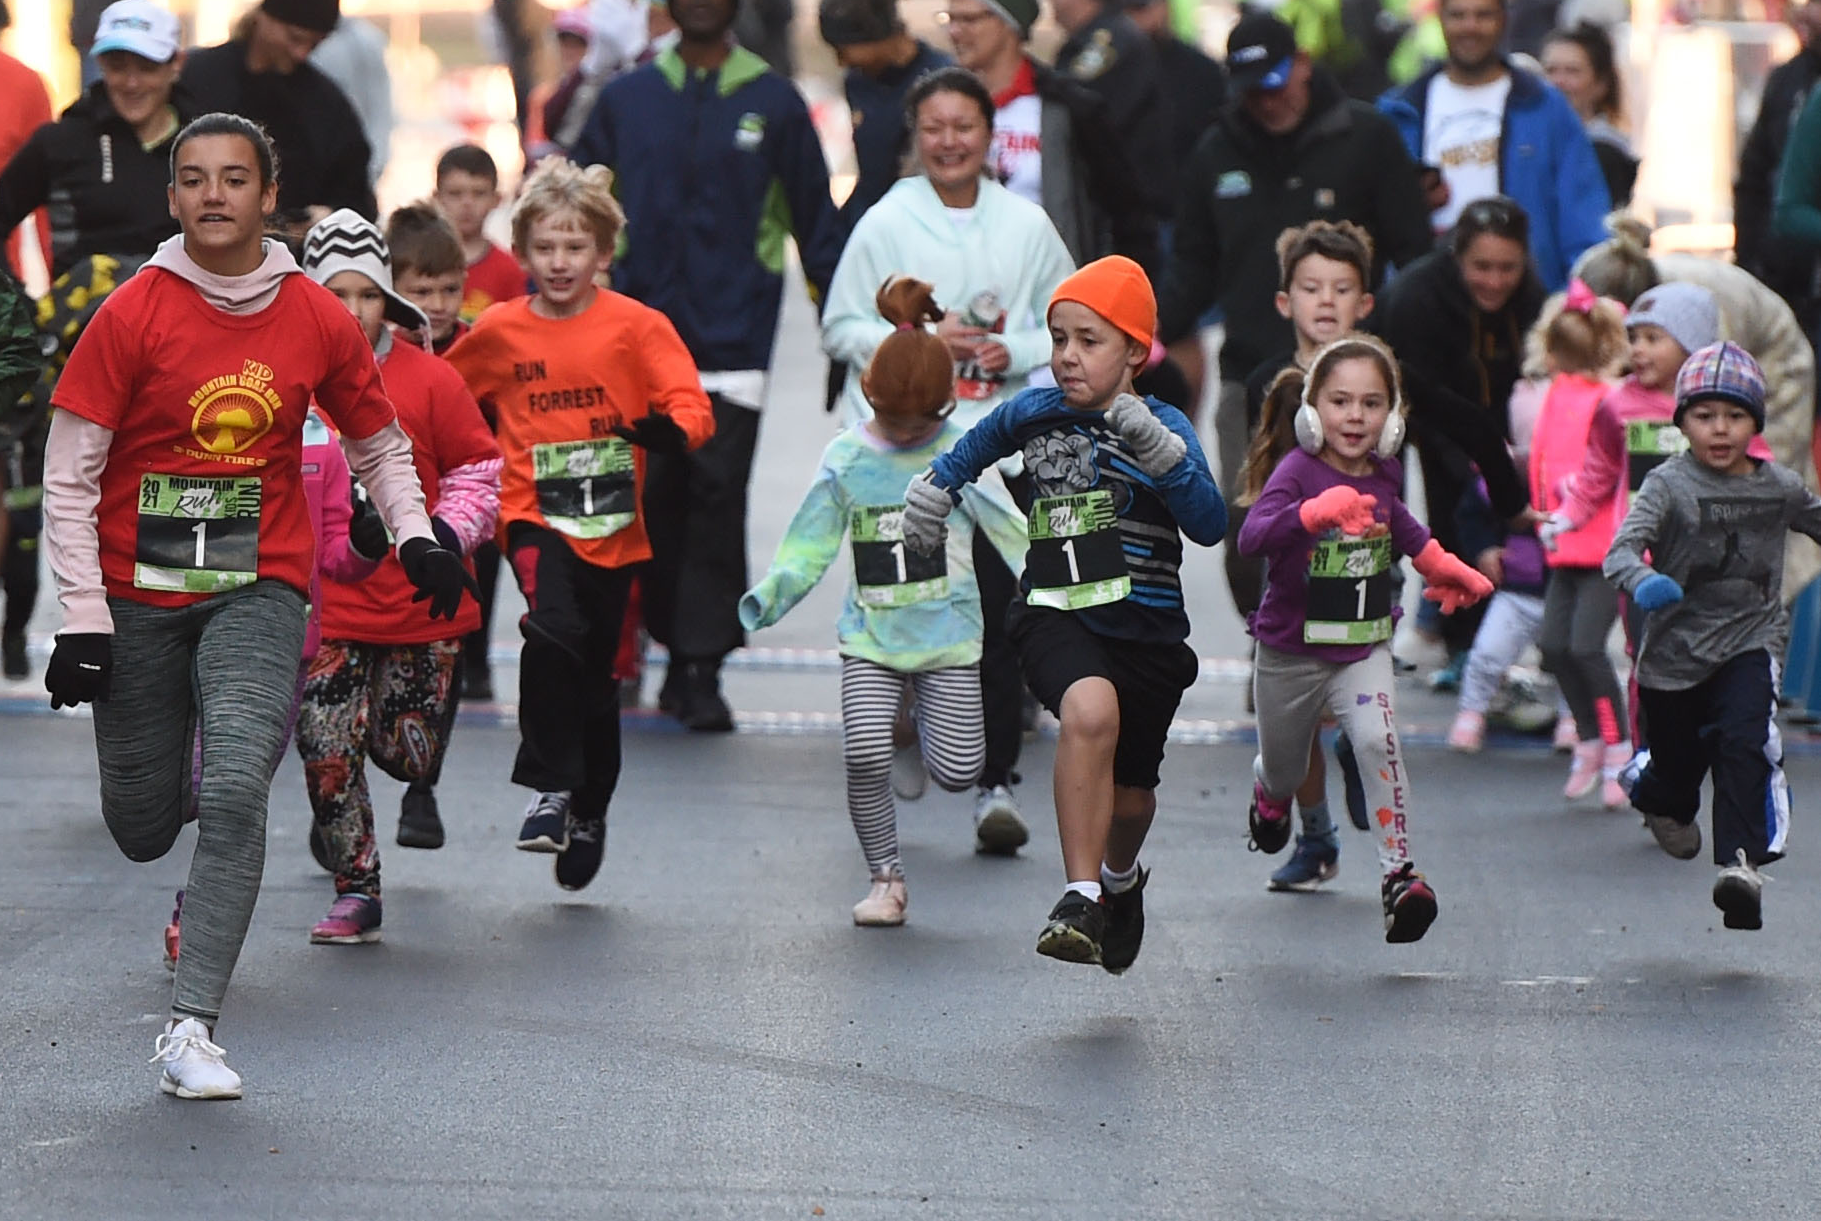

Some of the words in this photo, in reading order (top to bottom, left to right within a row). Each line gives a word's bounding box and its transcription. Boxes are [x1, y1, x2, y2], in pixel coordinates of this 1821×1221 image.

[242, 359, 274, 382] KID
[514, 360, 547, 381] RUN
[187, 374, 237, 408] MOUNTAIN
[529, 386, 605, 413] FORREST
[186, 448, 222, 463] DUNN
[223, 454, 256, 466] TIRE
[142, 479, 160, 494] 20
[168, 477, 236, 492] MOUNTAIN
[579, 478, 595, 515] 1
[141, 493, 159, 509] 21
[170, 492, 222, 517] Run
[237, 483, 261, 518] RUN
[191, 521, 207, 567] 1
[890, 541, 908, 583] 1
[1062, 539, 1081, 583] 1
[1355, 578, 1367, 620] 1
